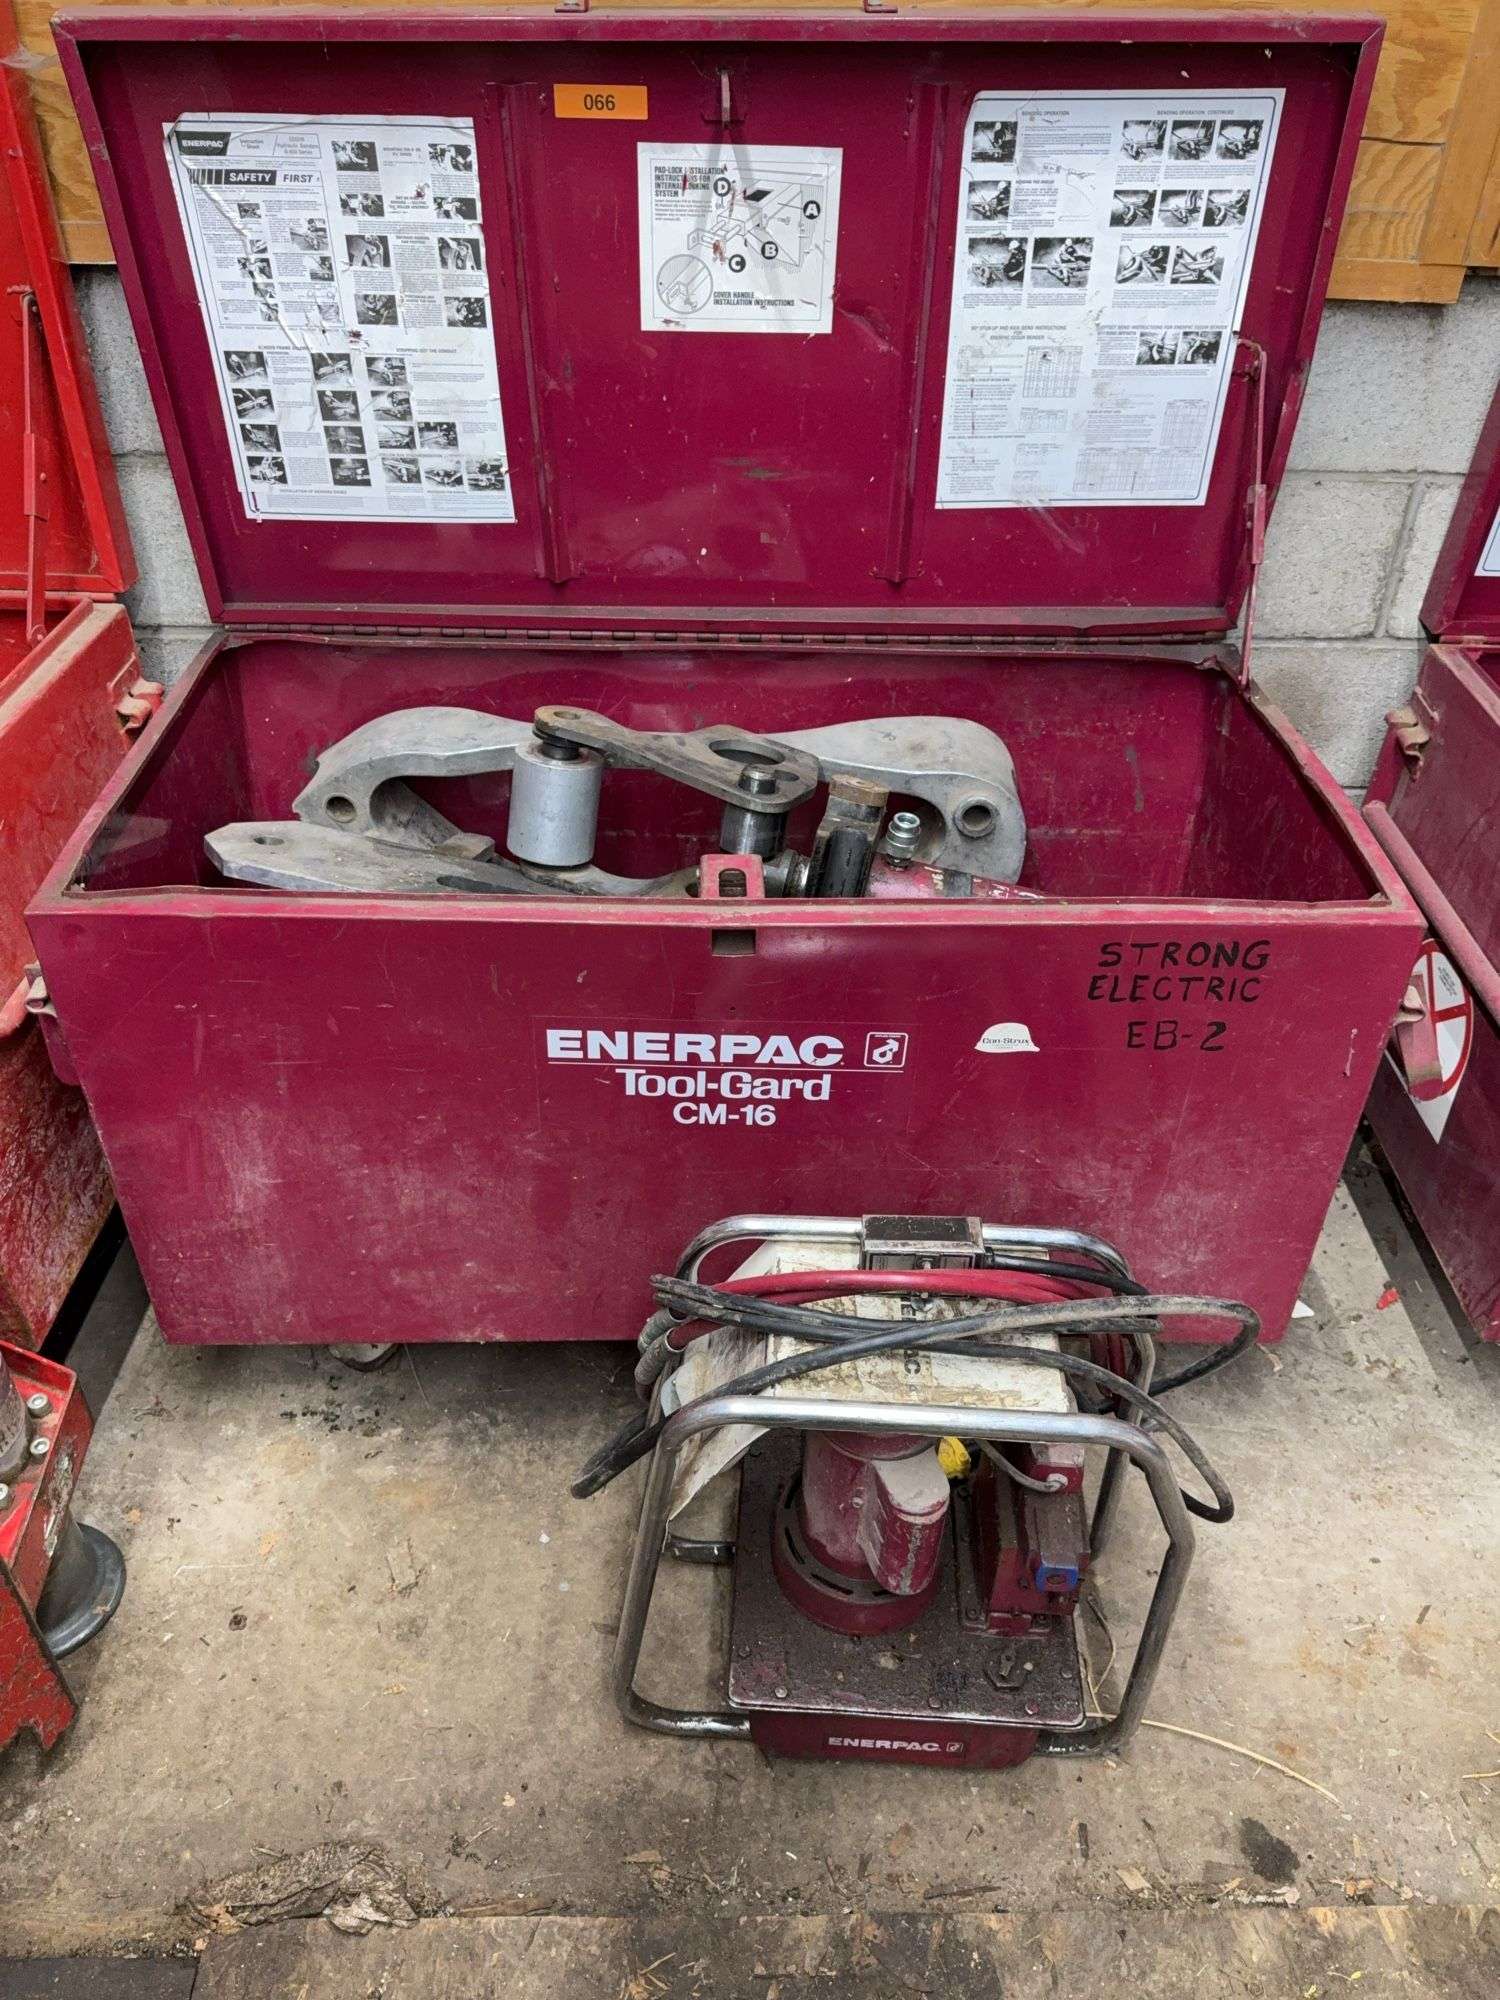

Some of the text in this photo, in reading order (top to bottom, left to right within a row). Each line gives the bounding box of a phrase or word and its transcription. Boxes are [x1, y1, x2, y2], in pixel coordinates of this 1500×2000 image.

[584, 94, 616, 111] 066
[181, 139, 226, 148] ENERPAC
[228, 172, 314, 184] SAFETY FIRST
[654, 166, 724, 175] PAD-LOCK ISTALLATION
[733, 291, 754, 299] HANDLE
[1098, 939, 1271, 971] STRONG
[1087, 974, 1262, 1002] ELECTRIC
[1127, 1020, 1227, 1052] EB-2
[546, 1029, 845, 1066] ENERPAC
[615, 1068, 832, 1100] Tool-Gard
[673, 1102, 777, 1126] CM-16
[828, 1737, 941, 1752] ENERPAC
